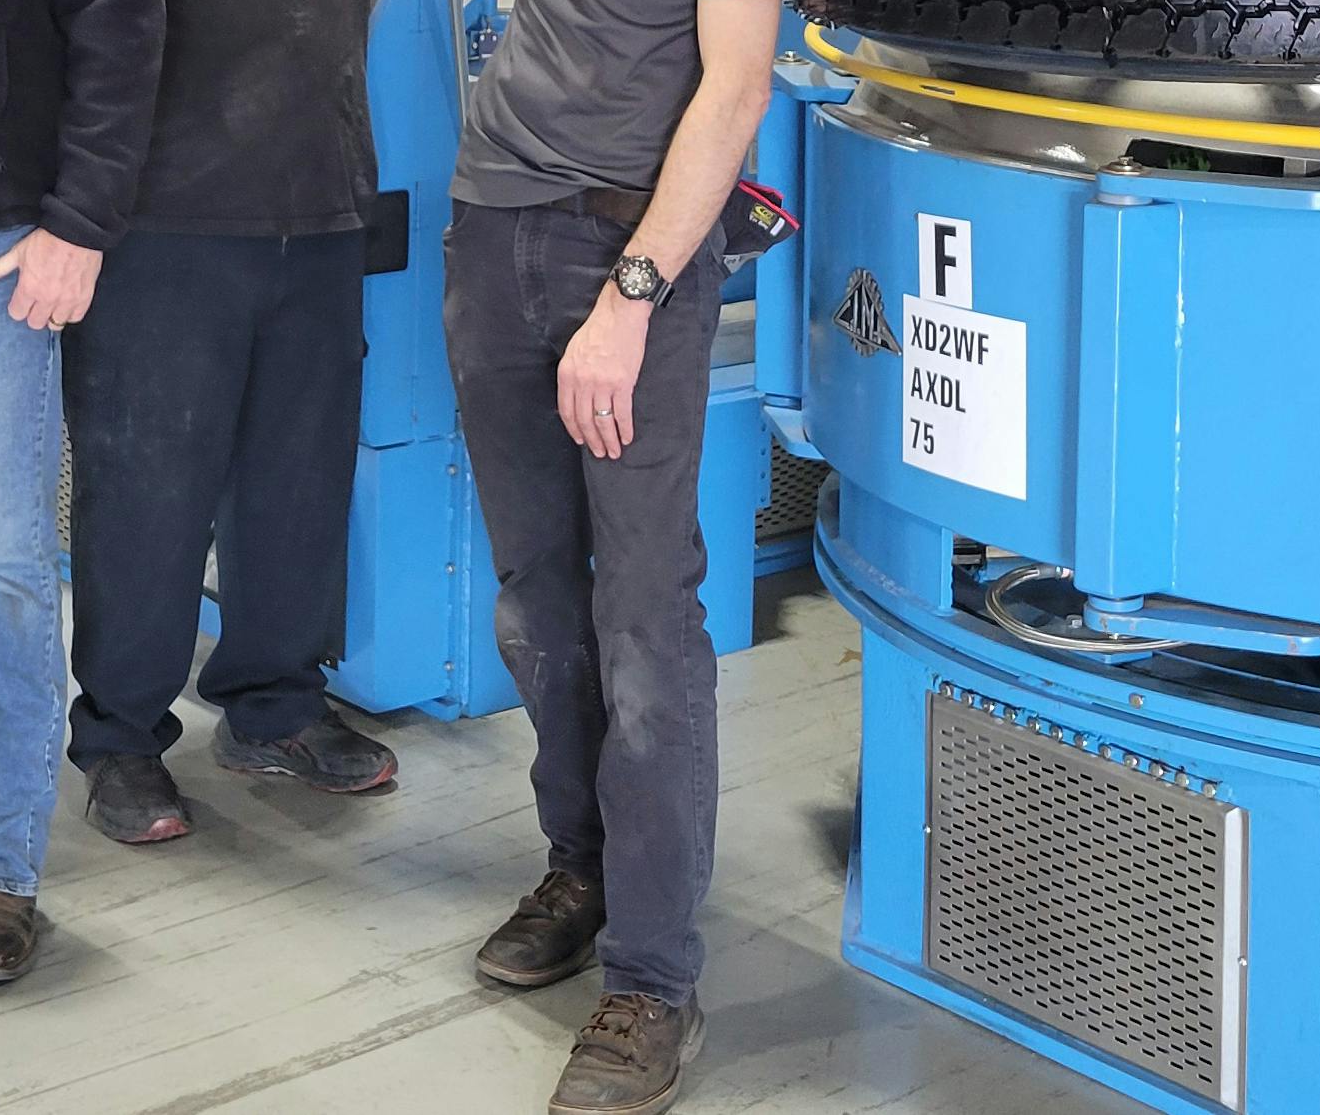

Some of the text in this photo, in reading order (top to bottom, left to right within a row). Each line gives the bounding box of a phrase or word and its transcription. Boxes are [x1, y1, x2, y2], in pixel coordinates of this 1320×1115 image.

[934, 222, 957, 297] F
[911, 314, 989, 365] XD2WF
[910, 367, 966, 413] AXDL
[910, 418, 935, 455] 75
